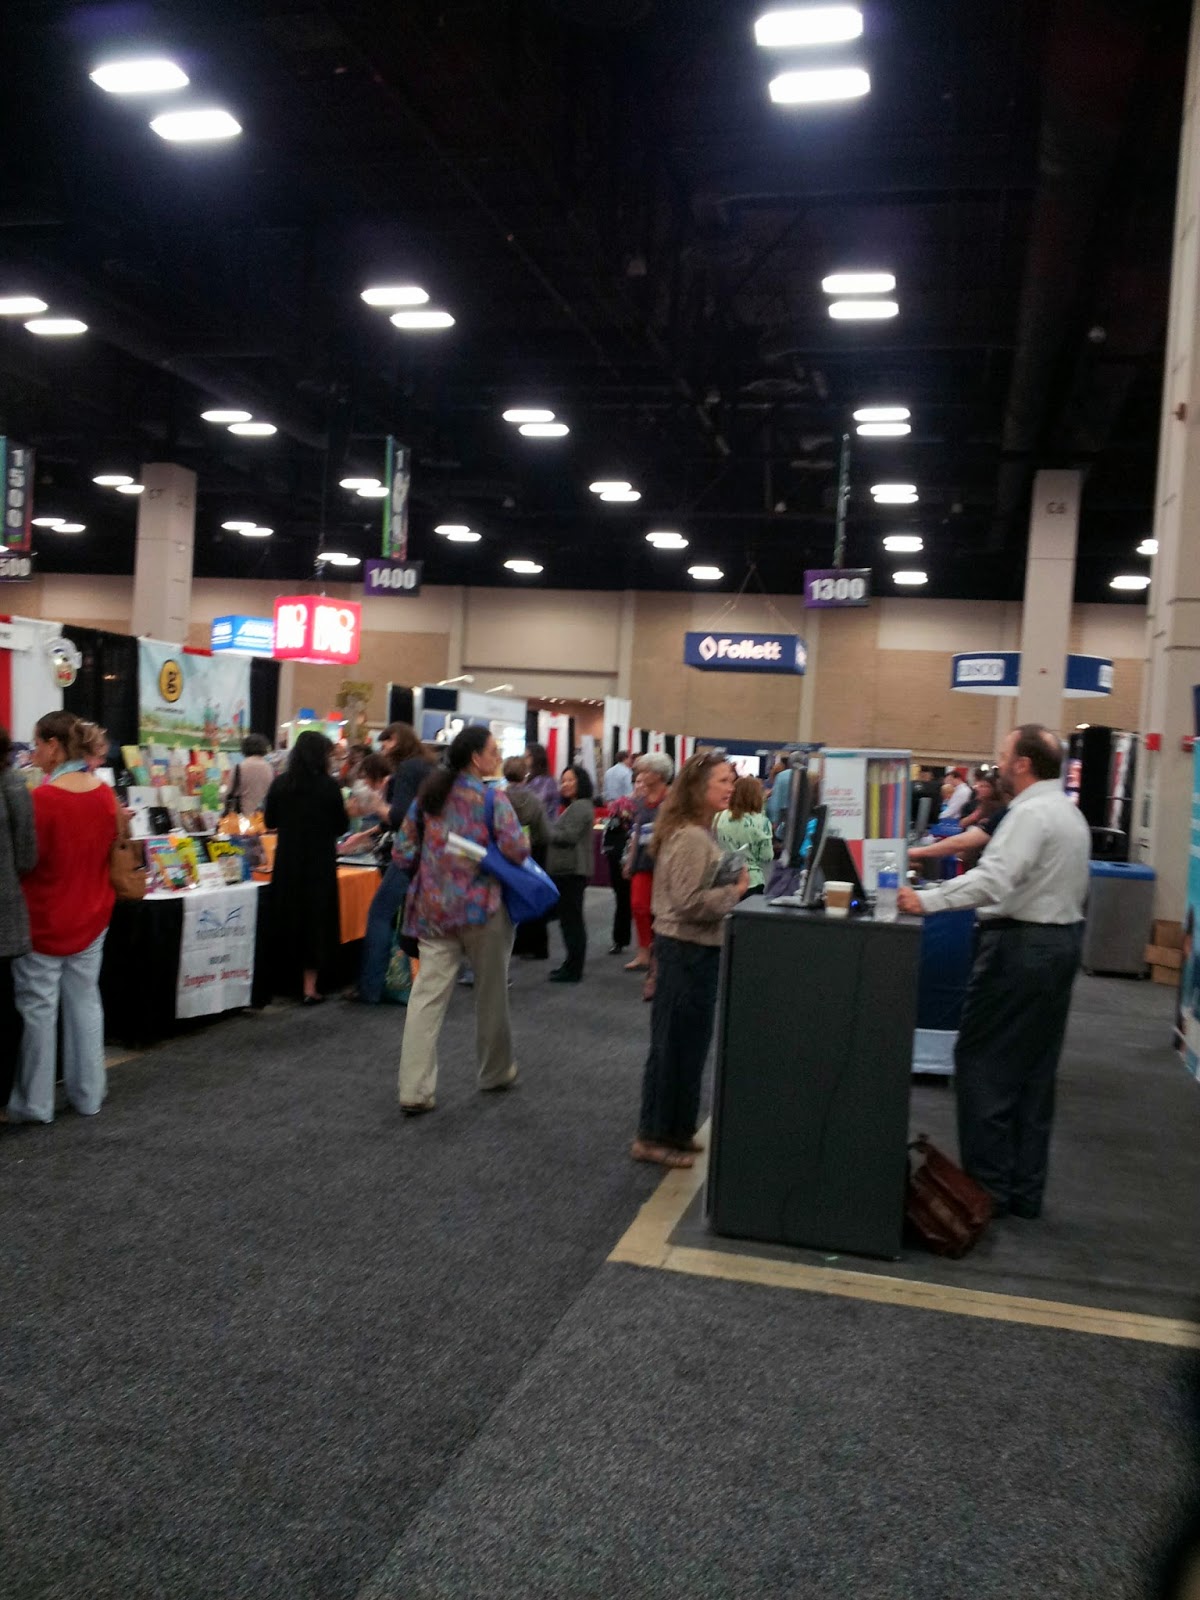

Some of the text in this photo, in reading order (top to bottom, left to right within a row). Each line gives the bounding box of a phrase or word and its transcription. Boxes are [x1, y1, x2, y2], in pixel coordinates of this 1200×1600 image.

[6, 449, 25, 528] 1500
[369, 568, 417, 589] 1400
[809, 578, 866, 600] 1300
[716, 639, 782, 660] Follett
